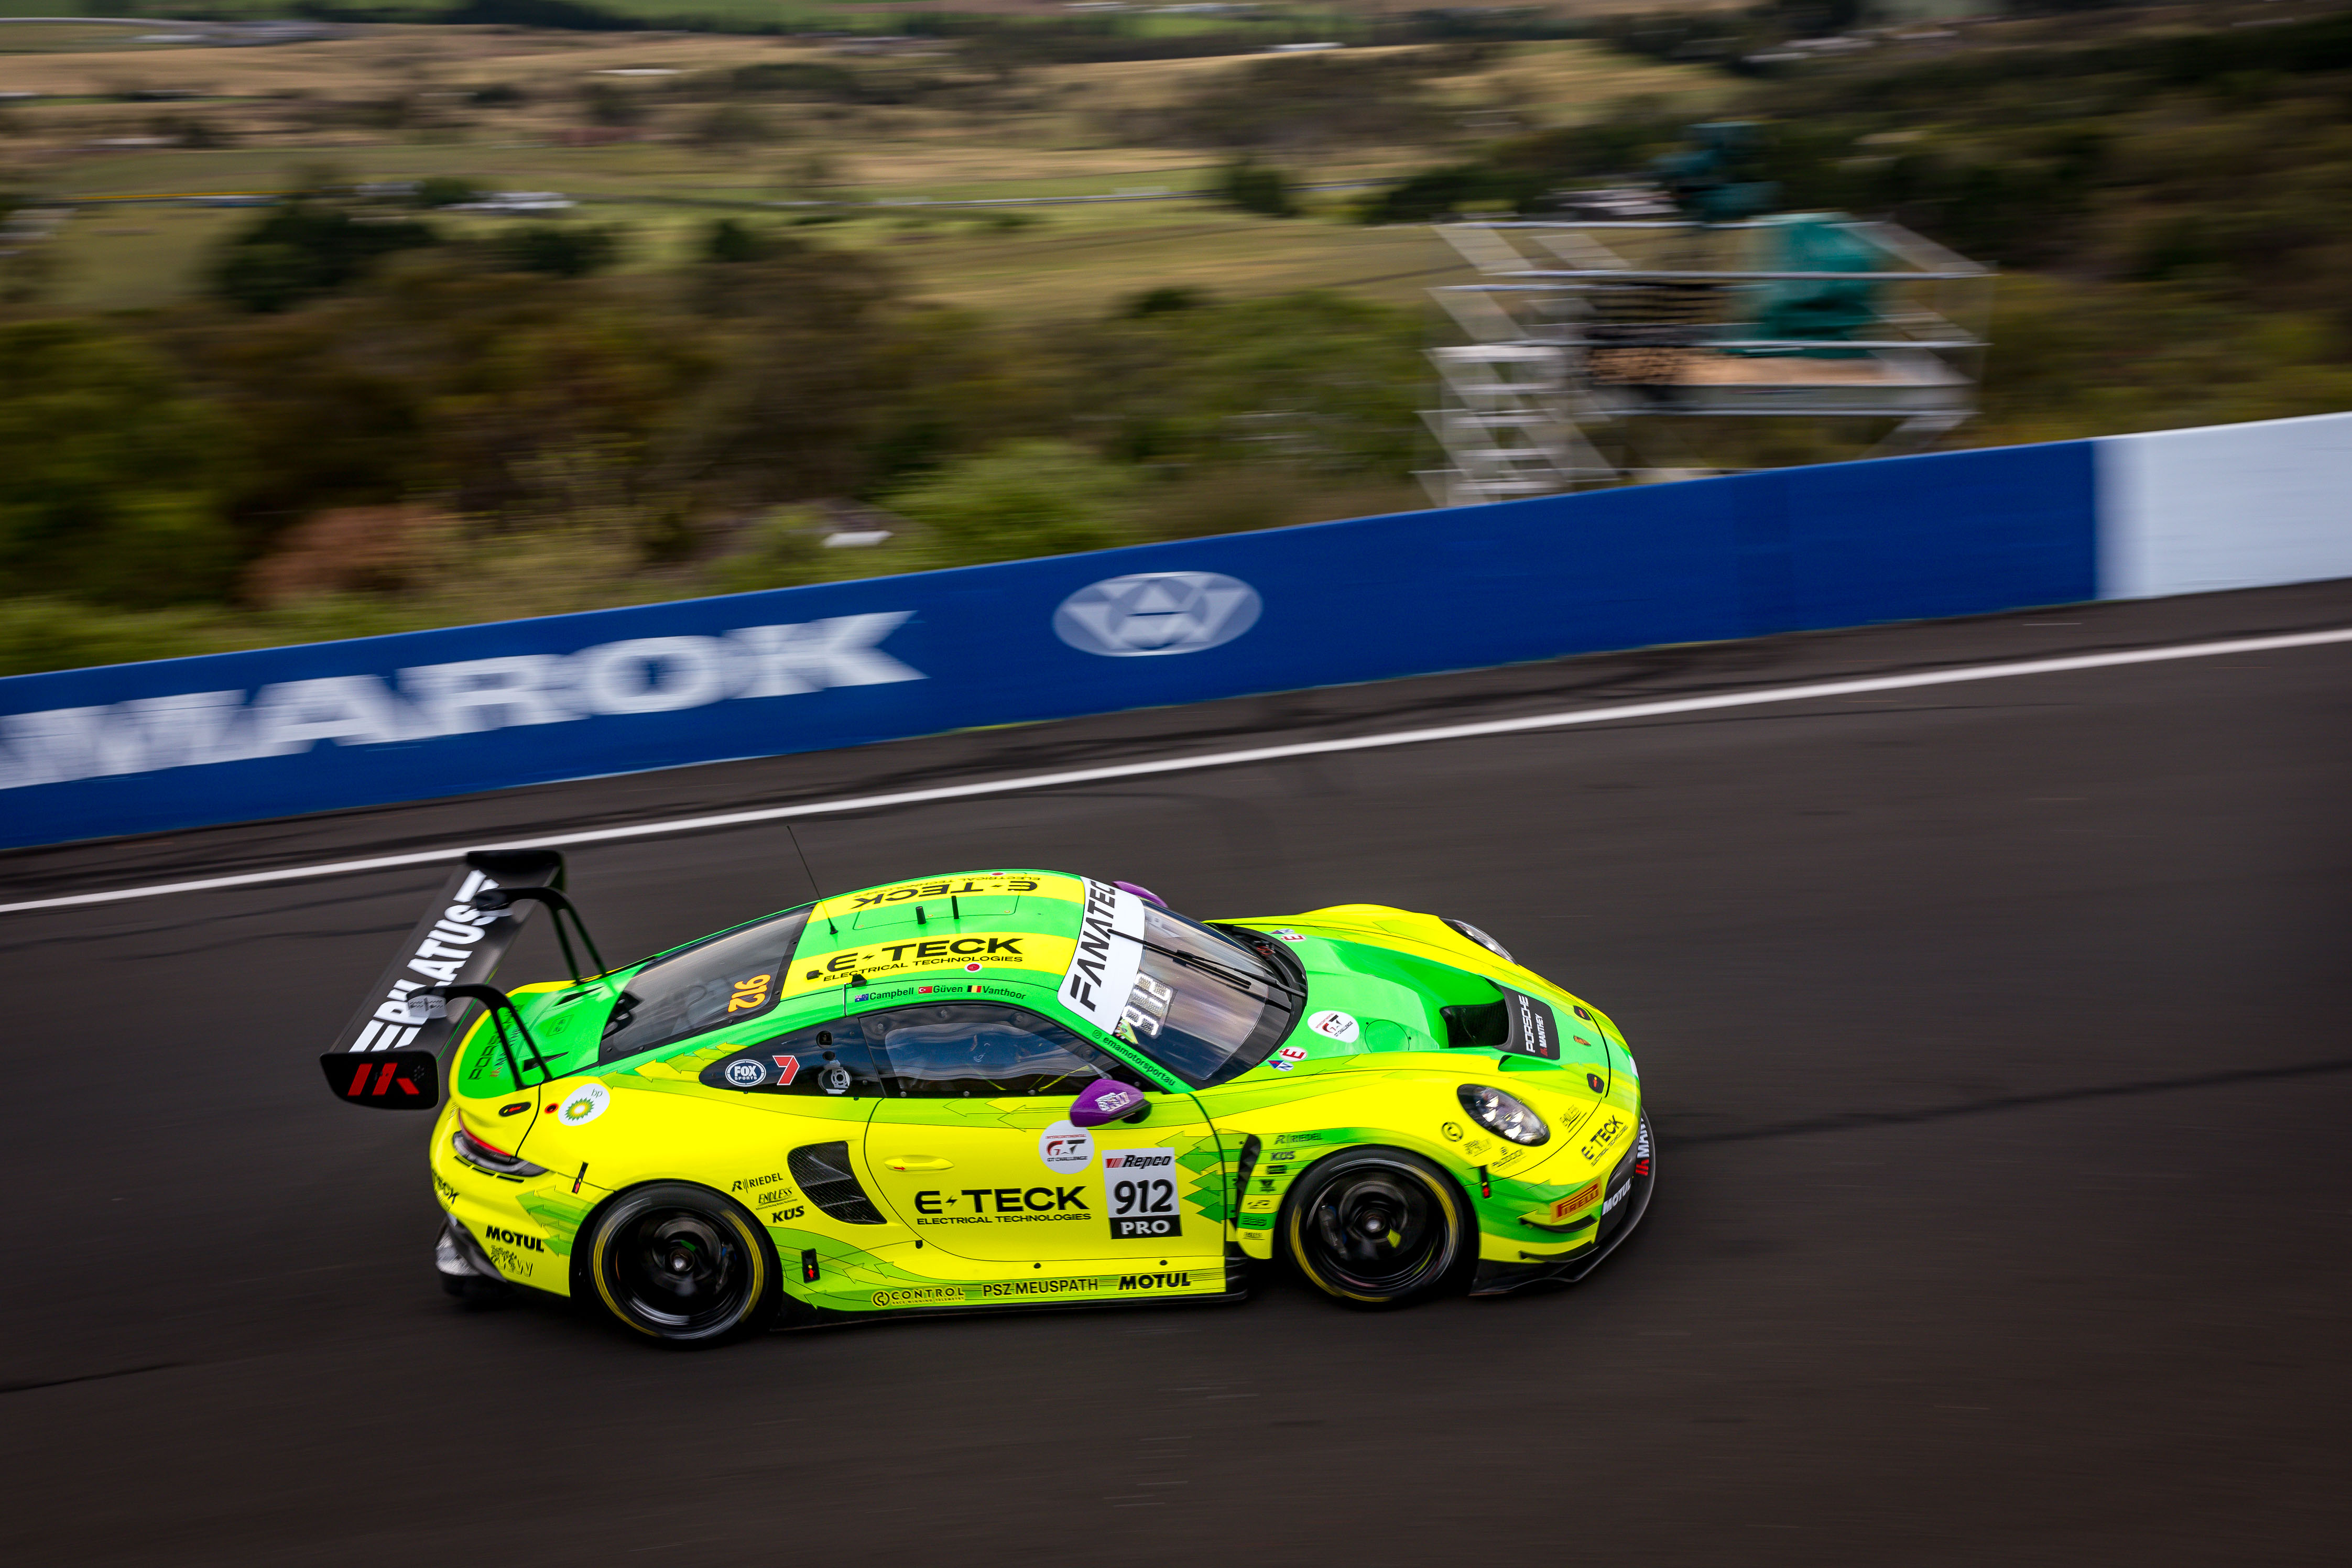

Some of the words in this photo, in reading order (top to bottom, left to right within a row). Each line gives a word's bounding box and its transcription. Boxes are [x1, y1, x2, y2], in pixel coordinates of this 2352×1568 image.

[1070, 880, 1115, 1012] FANATEC
[823, 963, 909, 982] ELECTRICAL
[912, 956, 1023, 968] TECHNOLOGIES
[728, 974, 771, 1012] 912
[869, 987, 914, 1001] Campbell
[933, 985, 963, 994] Güven
[982, 985, 1027, 1000] Vanthoor
[1518, 995, 1536, 1053] PORSCHE
[1535, 1013, 1547, 1048] MANTHEY
[1282, 1049, 1305, 1059] E
[734, 1065, 757, 1076] FOX
[772, 1055, 800, 1085] 7
[591, 1088, 603, 1098] bp
[1122, 1155, 1172, 1169] Repco
[749, 1173, 784, 1188] RIEDEL
[758, 1186, 792, 1204] ENDLESS
[1113, 1179, 1173, 1215] 912
[1556, 1183, 1599, 1218] PIRELLI
[1602, 1178, 1631, 1216] MOTUL
[771, 1205, 805, 1223] KÜS
[917, 1216, 993, 1225] ELECTRICAL
[995, 1213, 1092, 1223] TECHNOLOGIES
[1120, 1220, 1170, 1235] PRO
[485, 1225, 545, 1253] MOTUL
[983, 1283, 1012, 1297] PSZ
[1015, 1278, 1098, 1295] MEUSPATH
[1118, 1273, 1191, 1290] MOTUL
[892, 1287, 964, 1300] CONTROL
